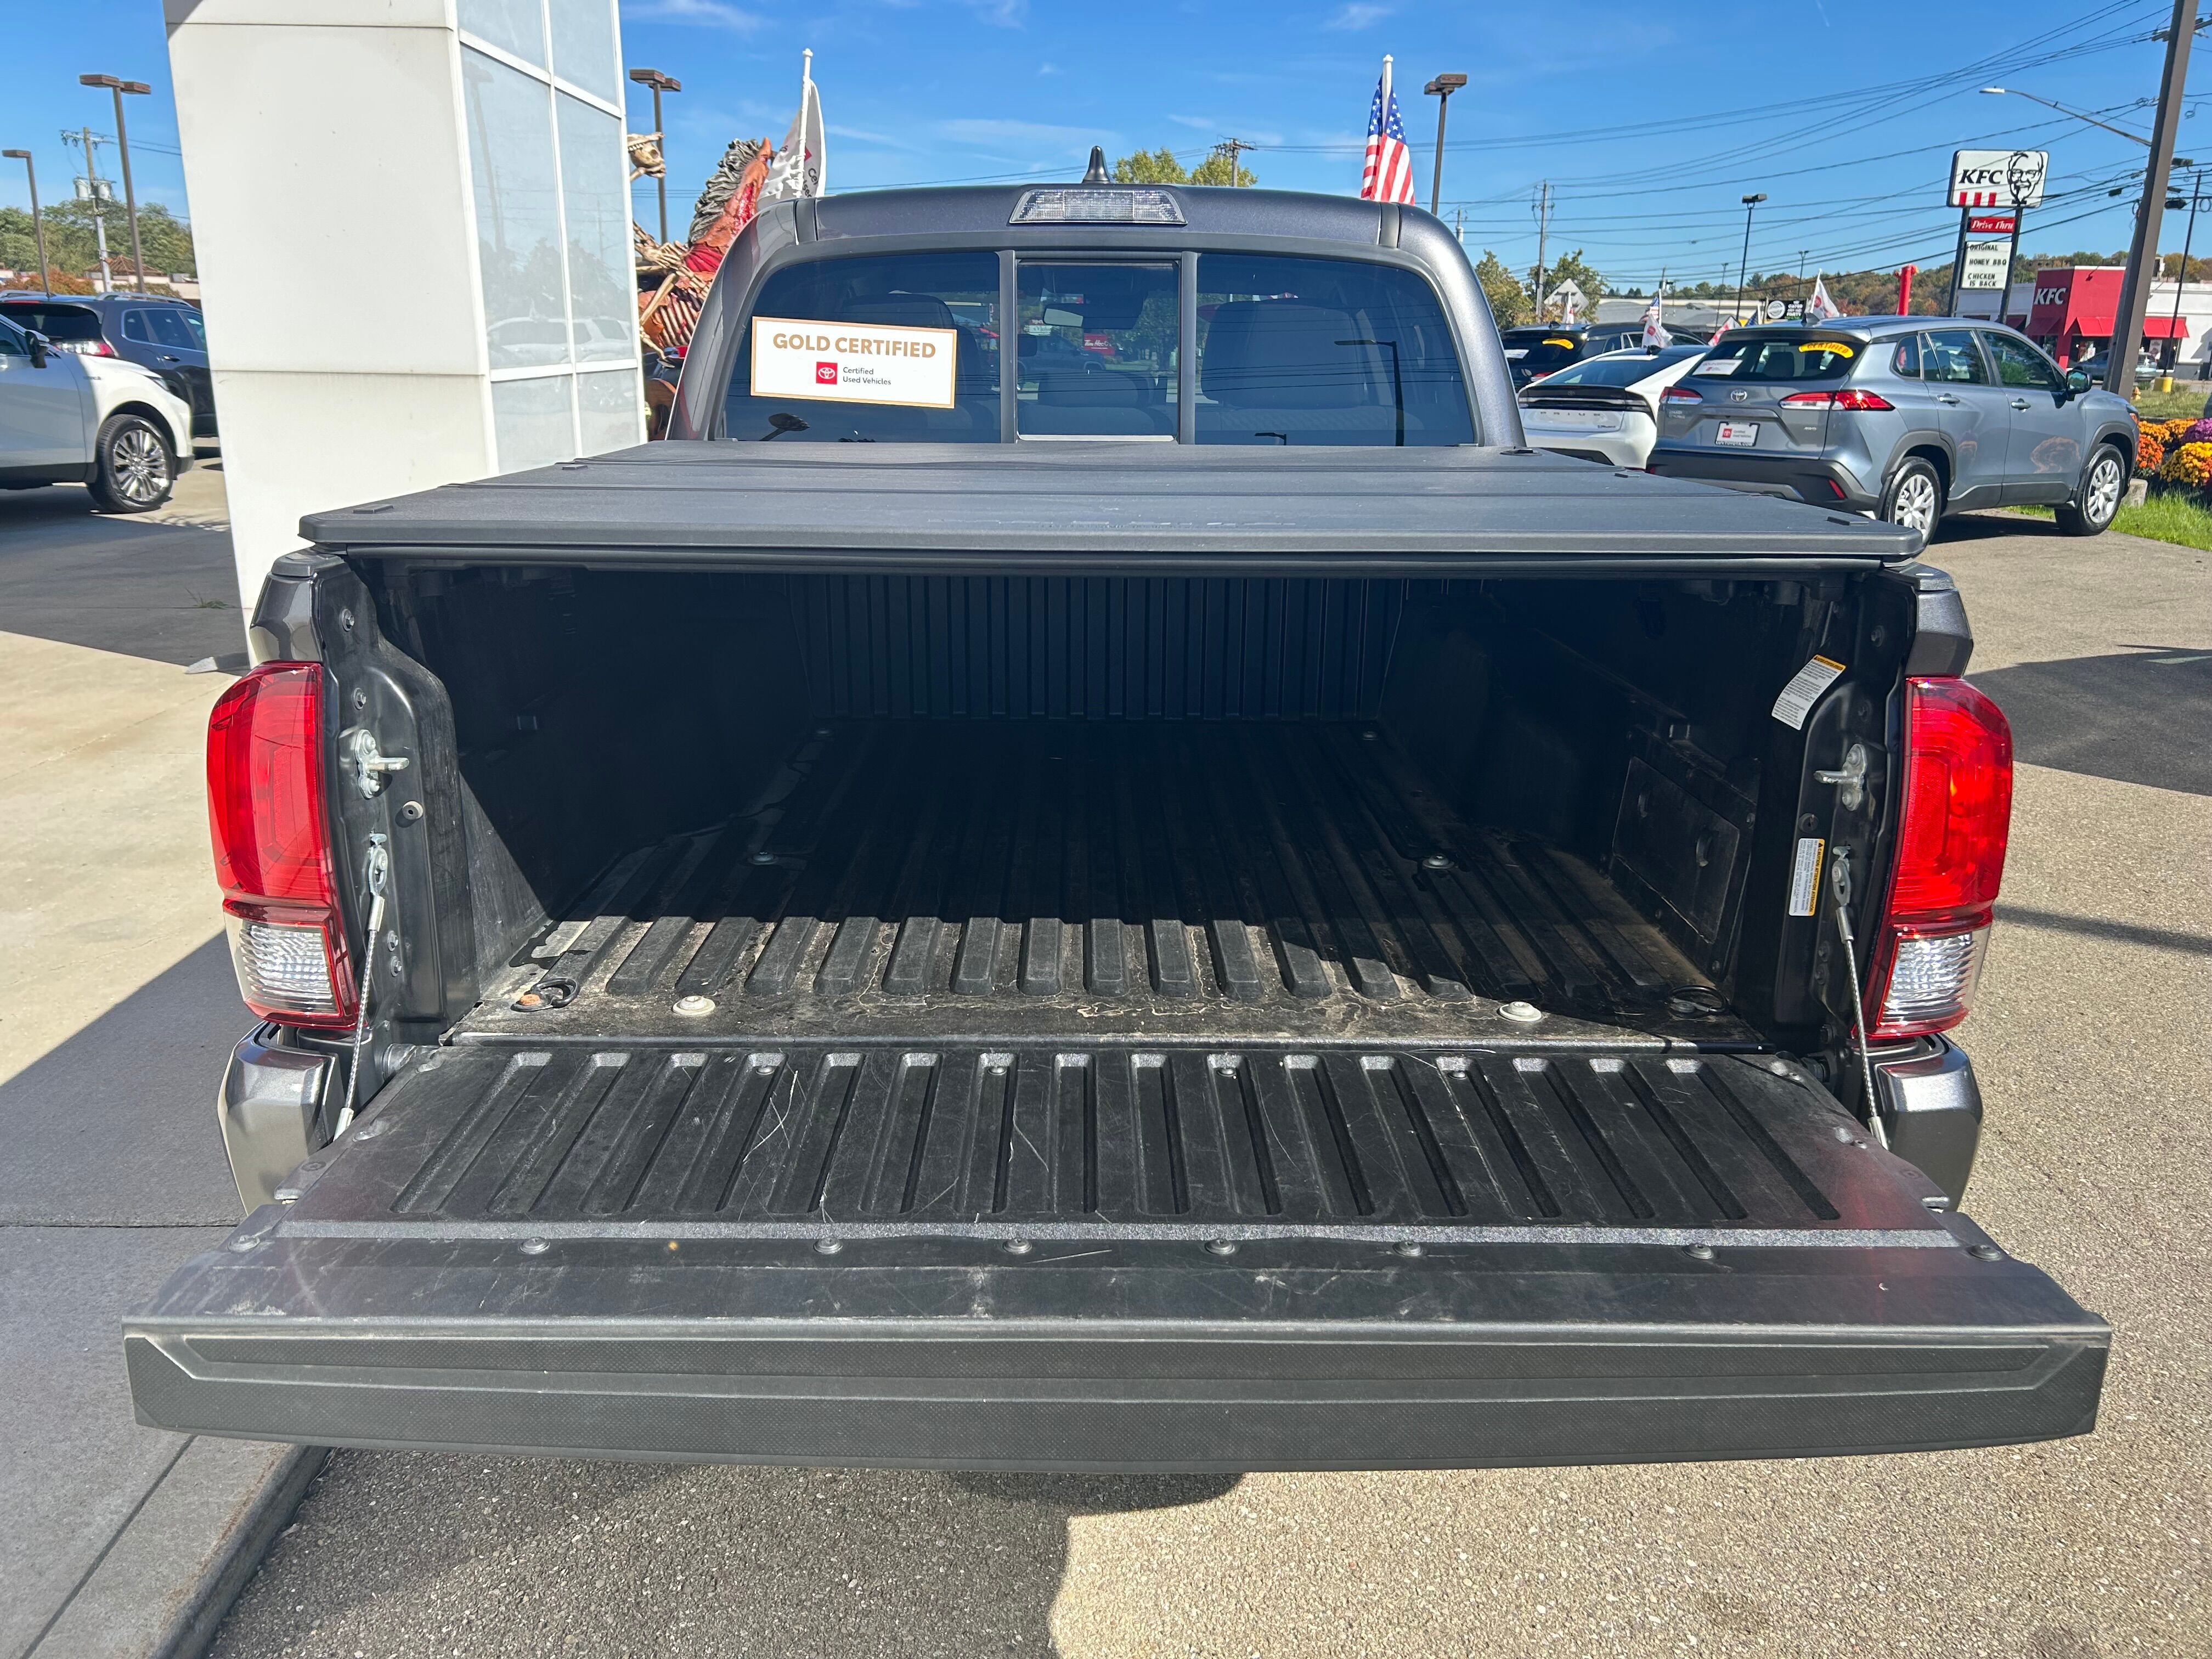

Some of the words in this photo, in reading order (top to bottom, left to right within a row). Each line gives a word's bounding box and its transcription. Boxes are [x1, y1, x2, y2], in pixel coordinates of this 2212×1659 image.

[1959, 169, 2004, 184] KFC
[1971, 219, 1993, 229] Drive
[1995, 220, 2013, 230] Thru
[2033, 287, 2067, 305] KFC
[773, 333, 831, 351] GOLD
[835, 337, 936, 358] CERTIFIED
[1807, 342, 1849, 353] CERTIFIED
[843, 366, 874, 375] Certified
[862, 377, 891, 386] Vehicles
